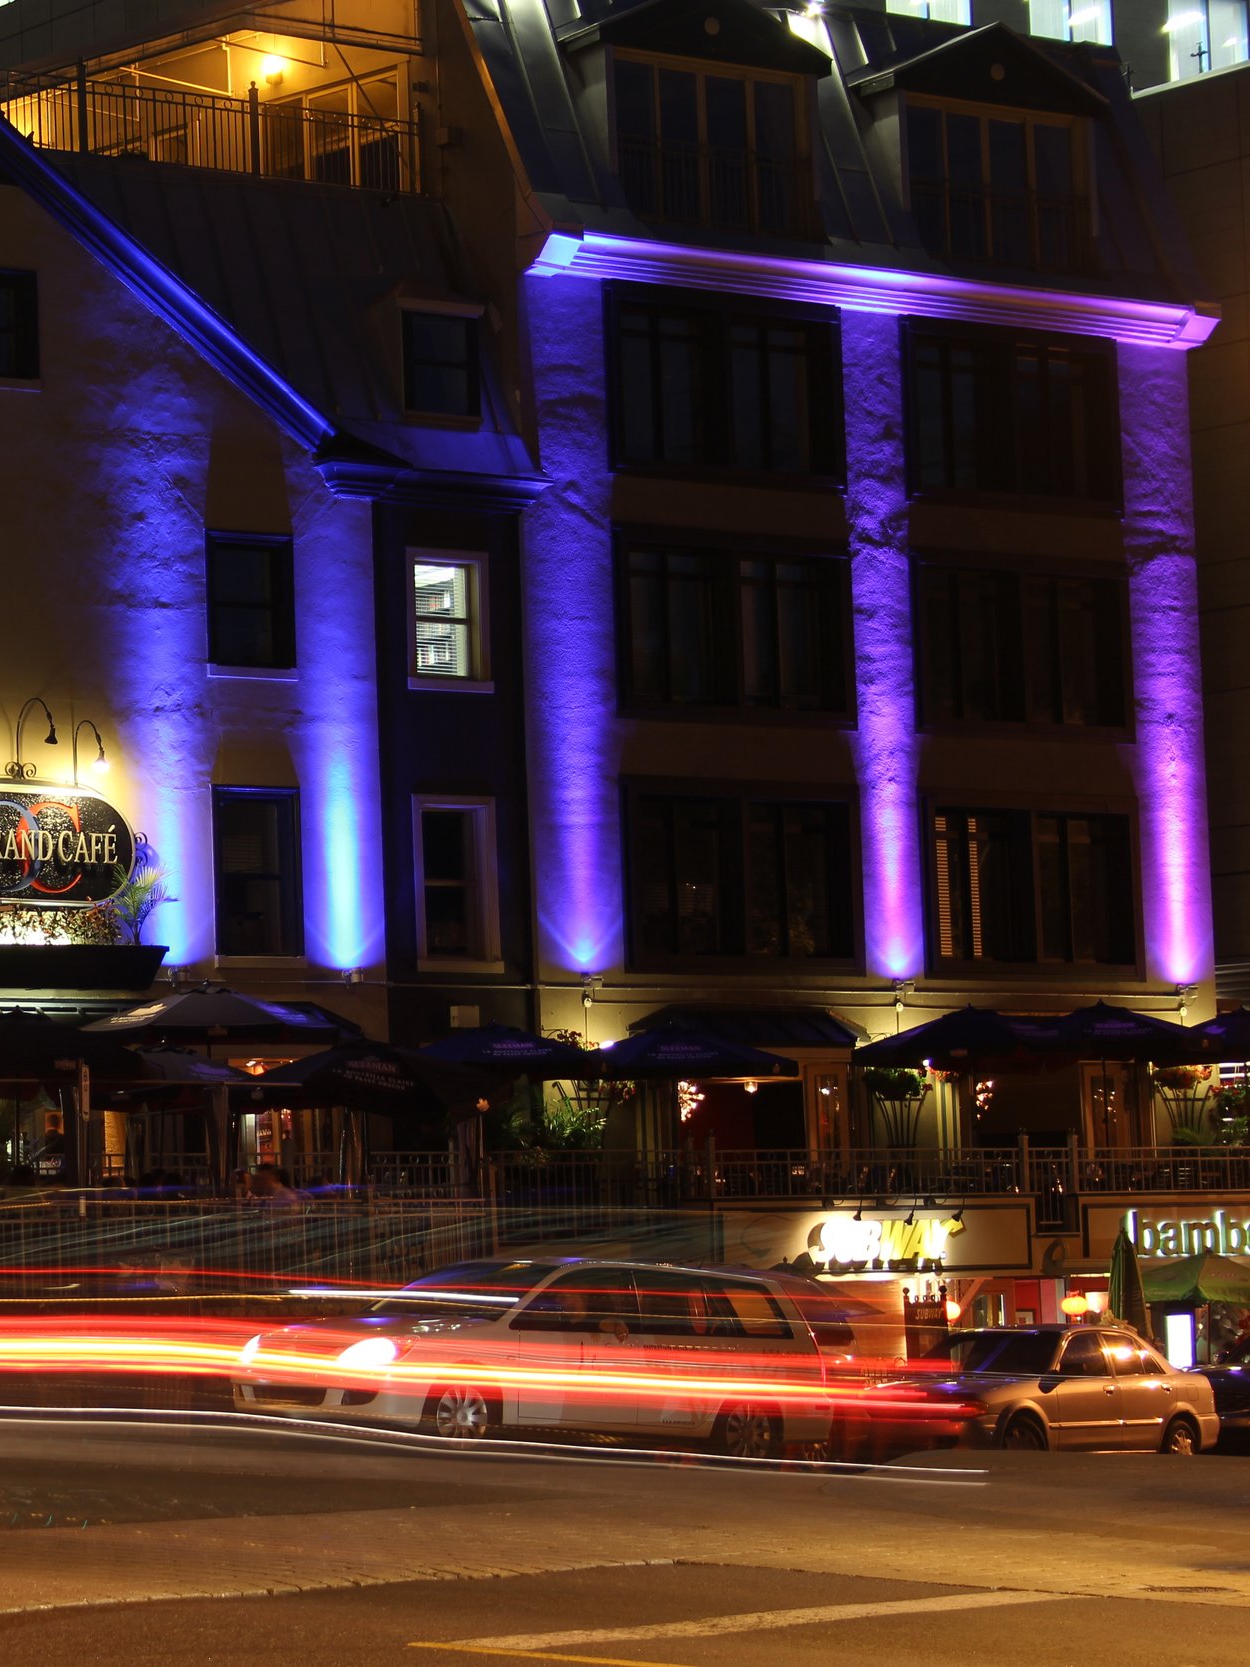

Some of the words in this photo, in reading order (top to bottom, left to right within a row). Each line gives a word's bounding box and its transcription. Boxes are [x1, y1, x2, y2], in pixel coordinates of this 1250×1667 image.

[58, 824, 118, 864] CAFÉ
[347, 1061, 397, 1073] SLEEMAN
[808, 1218, 964, 1263] SUBWAY
[1127, 1209, 1250, 1258] bamb
[915, 1308, 944, 1320] SUBWAY
